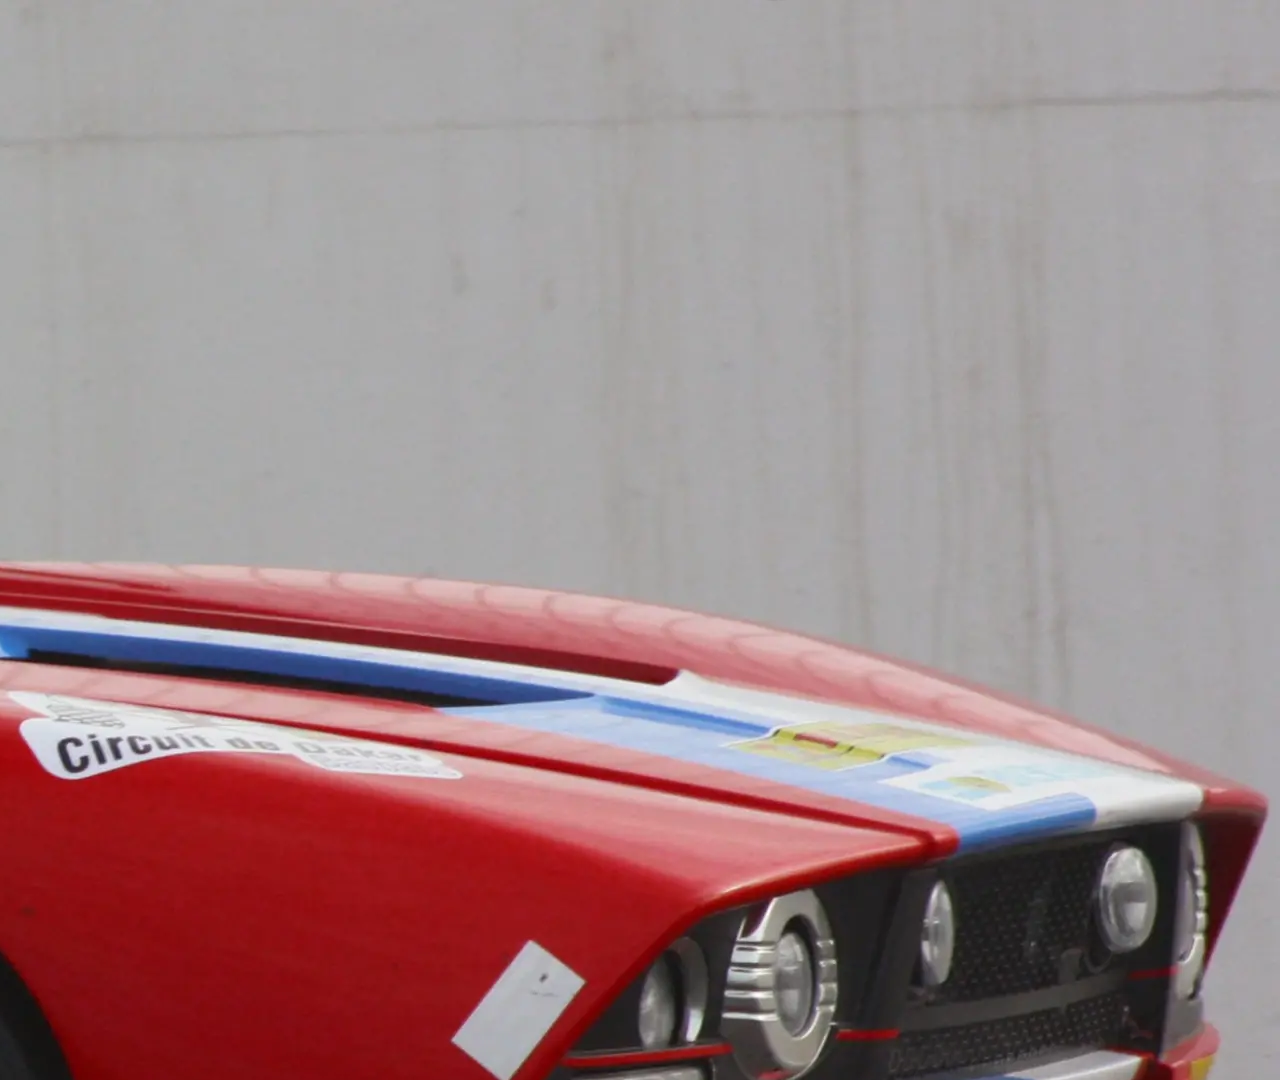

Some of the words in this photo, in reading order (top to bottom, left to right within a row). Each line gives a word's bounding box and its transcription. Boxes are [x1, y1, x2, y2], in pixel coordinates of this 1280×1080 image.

[57, 732, 215, 774] Circuit
[225, 735, 282, 752] de
[293, 740, 425, 764] Dakar
